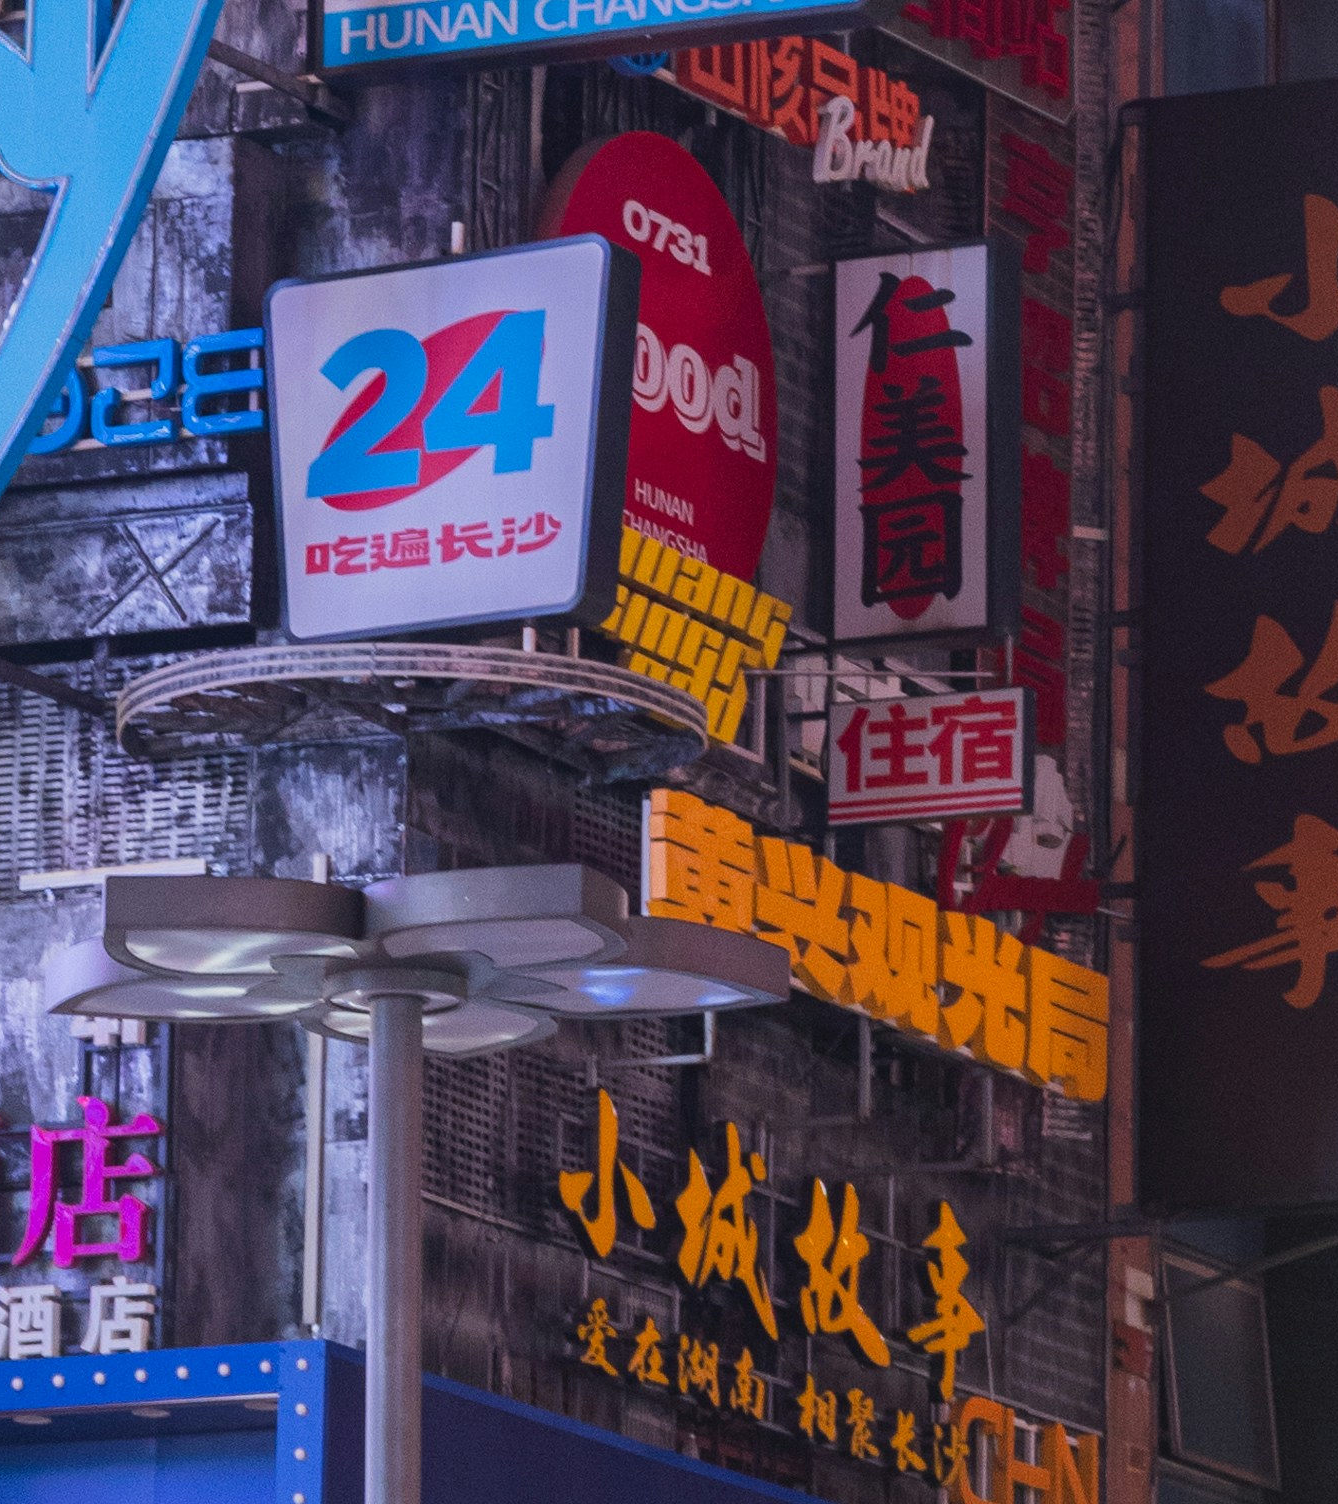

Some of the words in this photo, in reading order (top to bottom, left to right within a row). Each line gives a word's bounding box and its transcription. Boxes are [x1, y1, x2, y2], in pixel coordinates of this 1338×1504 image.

[340, 0, 518, 55] HUNAN
[814, 95, 933, 192] Brand
[623, 199, 711, 276] 0731
[304, 309, 554, 499] 24
[851, 271, 973, 606] 仁美园
[304, 512, 561, 576] 吃遍长沙
[634, 477, 695, 527] HUNAN
[837, 696, 1018, 793] 住宿
[559, 1088, 984, 1401] 小城故事
[577, 1298, 766, 1421] 爱在湖南
[797, 1373, 968, 1485] 相聚长沙
